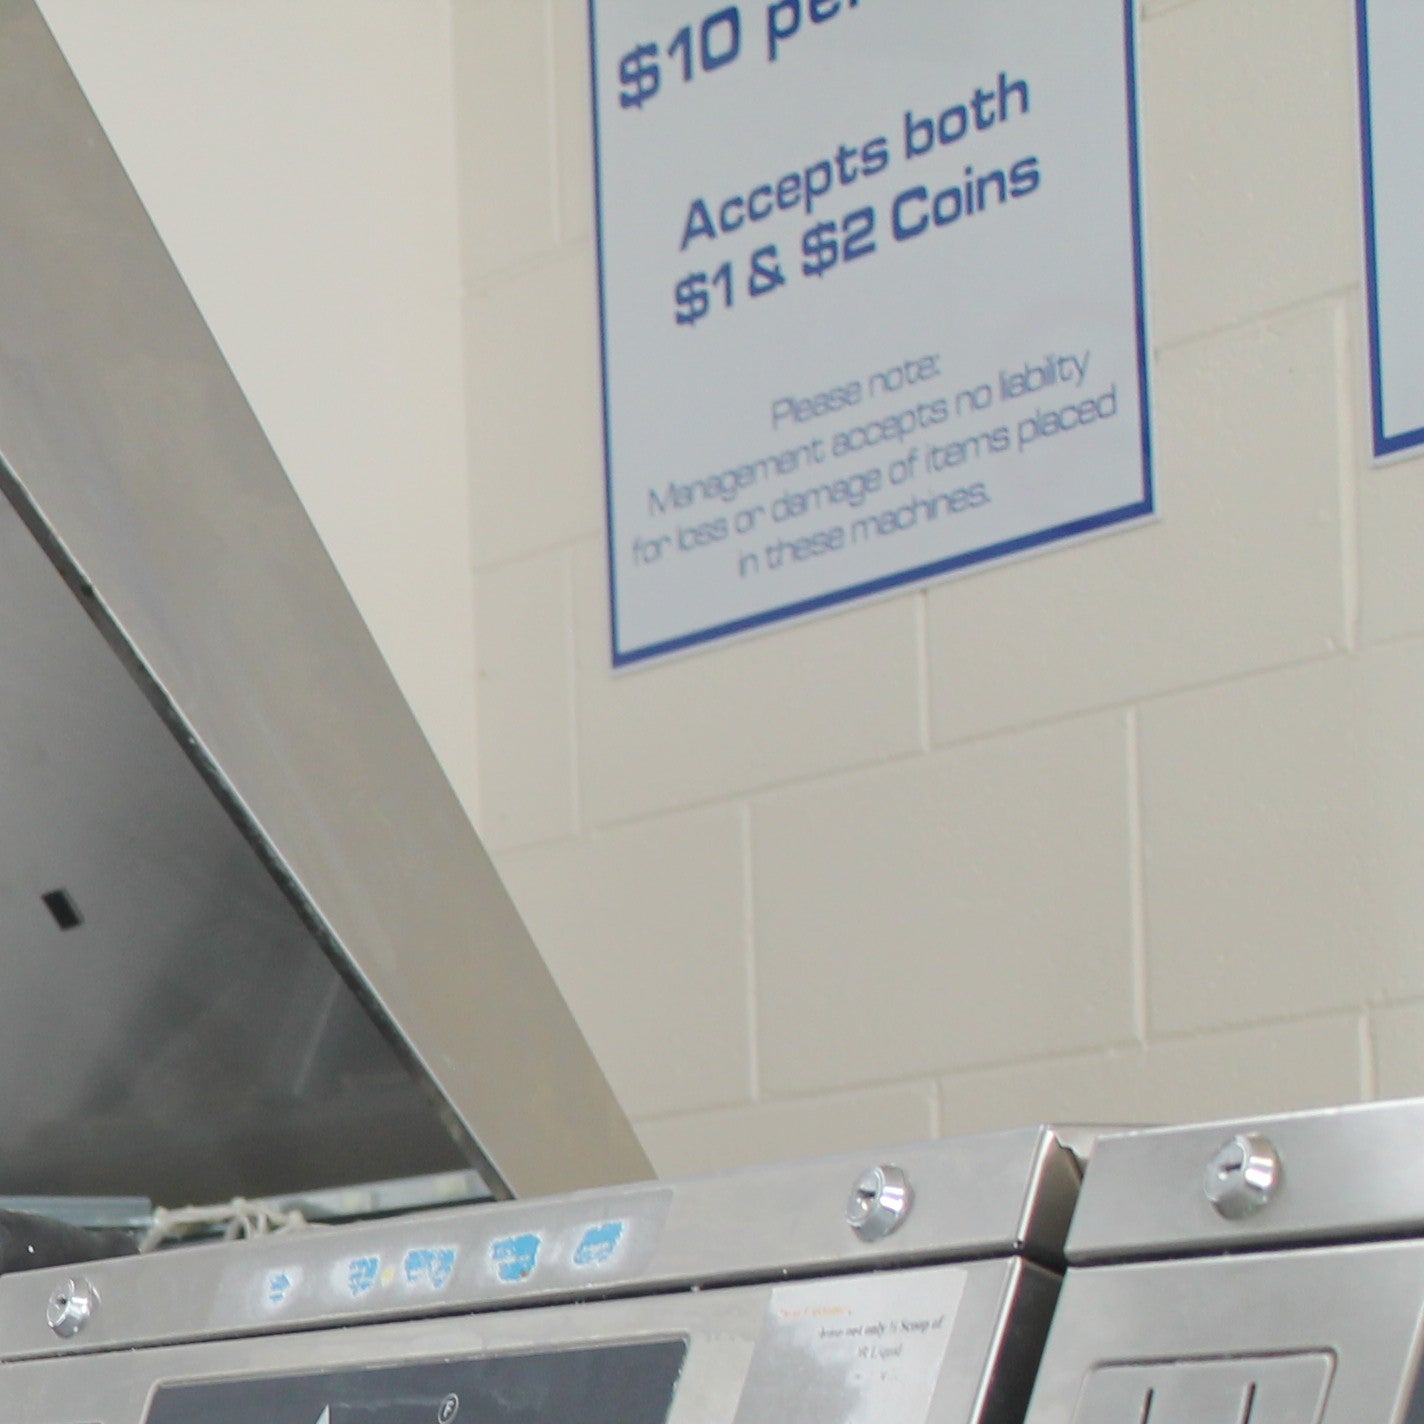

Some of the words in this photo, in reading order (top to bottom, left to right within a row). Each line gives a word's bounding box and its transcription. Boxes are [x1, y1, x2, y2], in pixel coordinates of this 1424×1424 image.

[618, 5, 741, 109] $10
[767, 0, 859, 62] pe
[674, 261, 734, 327] $1
[748, 244, 786, 298] &
[802, 205, 877, 278] $2
[891, 155, 1041, 242] Coins
[679, 136, 890, 251] Accepts
[904, 71, 1030, 159] both
[632, 535, 672, 566] for
[678, 517, 729, 551] loss
[734, 505, 766, 535] or
[770, 467, 882, 523] damage
[888, 448, 919, 485] of
[925, 425, 1011, 473] items
[1017, 382, 1118, 454] placed
[648, 438, 825, 516] Management
[832, 398, 949, 458] accepts
[955, 383, 993, 416] no
[998, 350, 1090, 402] liability
[770, 380, 862, 431] Please
[869, 353, 941, 398] note:
[738, 549, 760, 578] in
[765, 526, 845, 570] these
